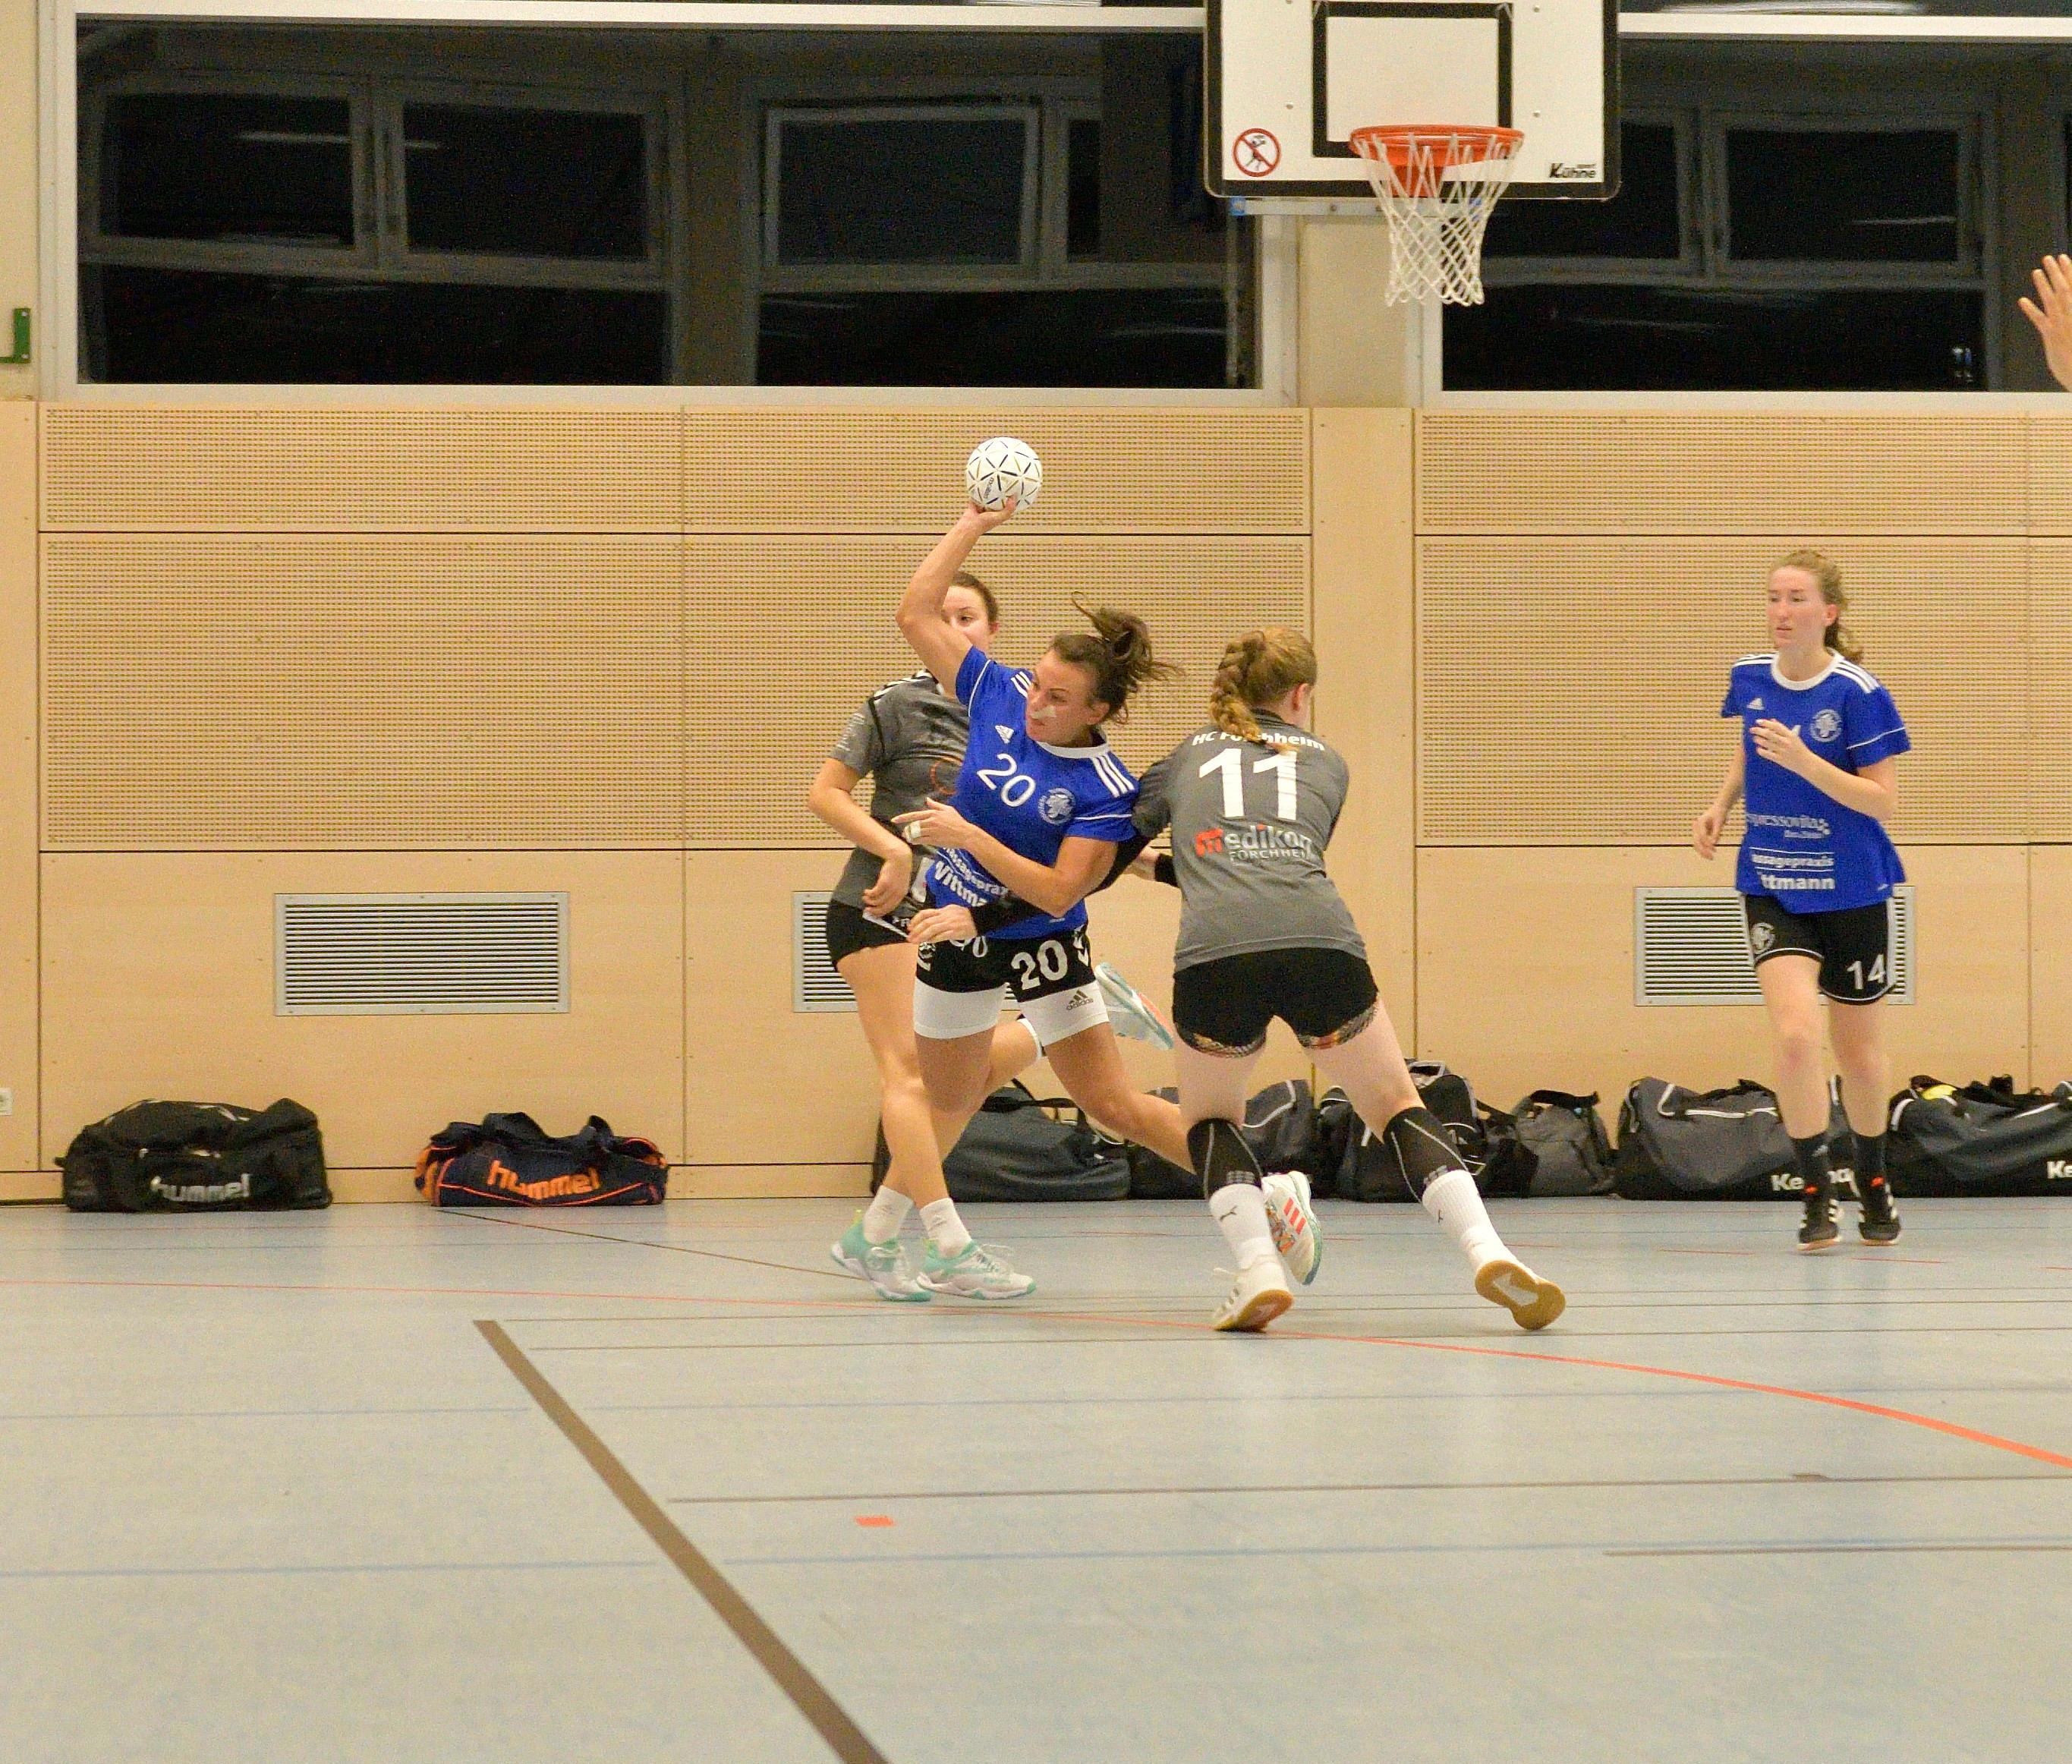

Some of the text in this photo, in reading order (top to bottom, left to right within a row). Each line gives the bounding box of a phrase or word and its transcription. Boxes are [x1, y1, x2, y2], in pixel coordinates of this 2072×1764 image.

[1192, 731, 1217, 746] HC
[977, 754, 1036, 808] 20
[1198, 748, 1297, 821] 11
[1195, 823, 1312, 858] medikon
[1011, 940, 1067, 990] 20
[1847, 953, 1885, 990] 14
[487, 1160, 599, 1200] hummel
